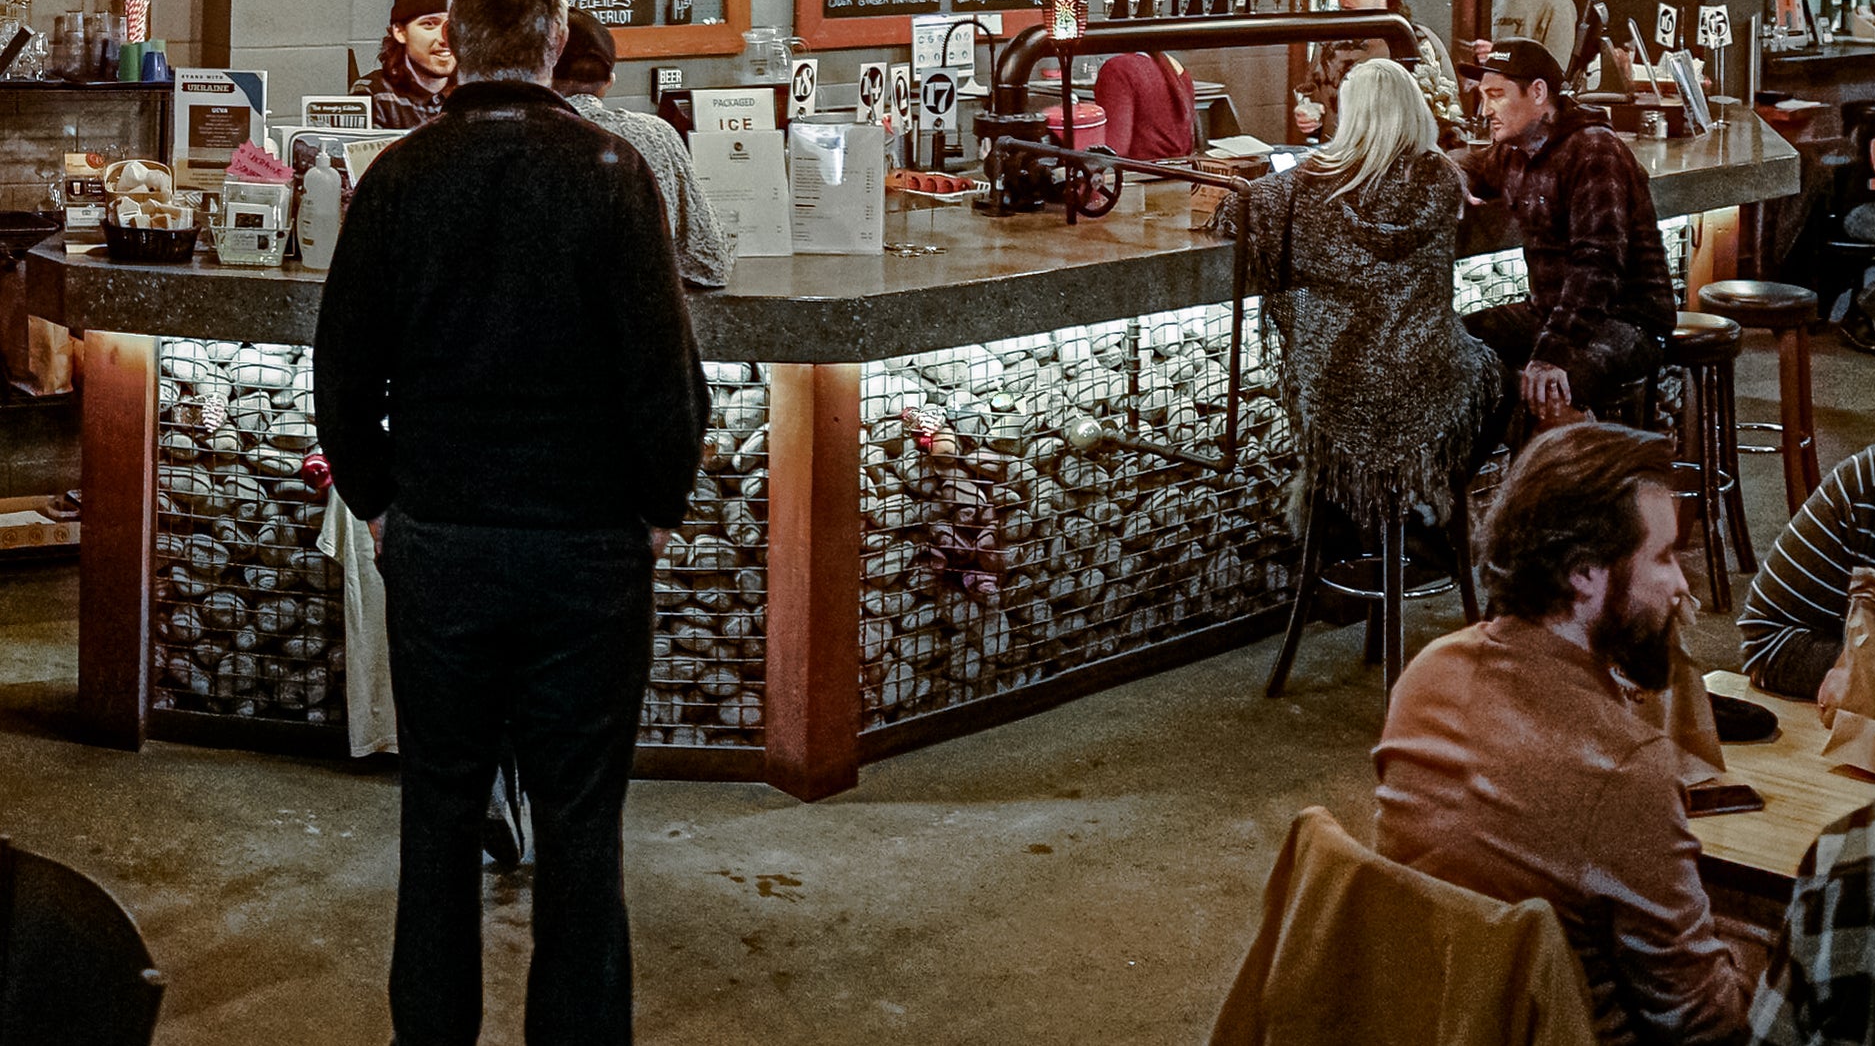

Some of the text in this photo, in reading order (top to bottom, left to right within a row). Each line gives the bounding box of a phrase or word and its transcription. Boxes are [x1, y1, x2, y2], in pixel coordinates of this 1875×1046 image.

[1661, 14, 1673, 31] 16
[660, 68, 682, 84] BEER
[795, 68, 812, 96] 18
[187, 84, 230, 92] UKRAINE
[863, 73, 882, 100] 14
[713, 97, 755, 107] PACKAGED
[925, 82, 952, 113] 17
[719, 118, 753, 131] ICE
